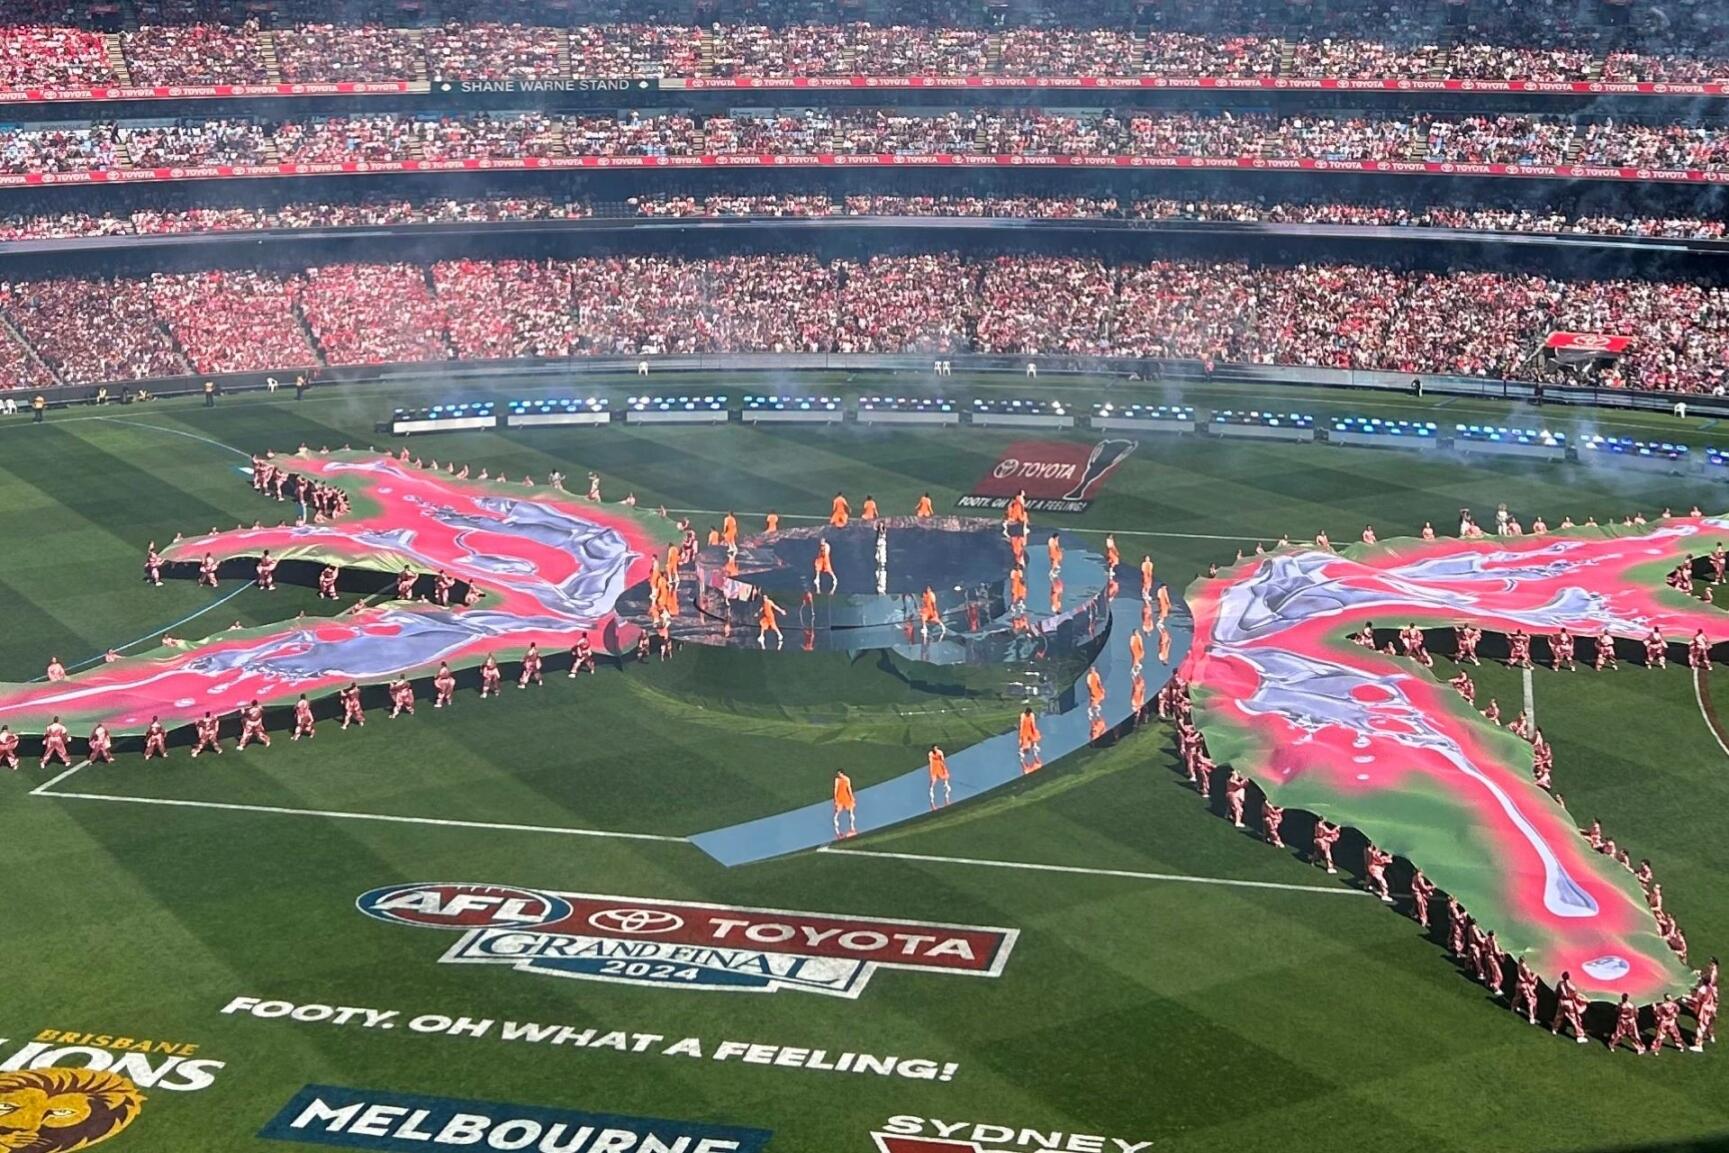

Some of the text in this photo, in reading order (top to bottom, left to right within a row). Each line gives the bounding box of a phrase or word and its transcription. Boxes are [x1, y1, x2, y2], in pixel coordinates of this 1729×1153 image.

[367, 83, 399, 91] TOYOTA
[461, 80, 629, 92] SHANE WARNE STAND
[60, 90, 92, 98] TOYOTA
[184, 87, 216, 95] TOYOTA
[0, 92, 27, 100] OYOTA
[551, 158, 583, 166] TOYOTA
[729, 156, 760, 164] TOYOTA
[1084, 157, 1116, 165] TOYOTA
[1268, 160, 1300, 168] TOYOTA
[308, 164, 342, 172] TOYOTA
[370, 162, 403, 170] TOYOTA
[431, 161, 464, 169] TOYOTA
[1329, 161, 1362, 169] TOYOTA
[1392, 163, 1426, 171] TOYOTA
[1455, 164, 1489, 172] TOYOTA
[185, 168, 219, 176] TOYOTA
[247, 166, 280, 174] TOYOTA
[1520, 166, 1555, 174] TOYOTA
[1586, 168, 1621, 177] TOYOTA
[56, 173, 90, 181] TOYOTA
[121, 170, 155, 179] TOYOTA
[1652, 171, 1688, 179] TOYOTA
[0, 176, 26, 184] OYOTA
[1017, 463, 1077, 479] TOYOTA
[993, 498, 1009, 508] OH
[1045, 501, 1087, 511] FEELING!
[369, 891, 545, 922] AFL
[708, 917, 976, 961] TOYOTA
[478, 933, 841, 984] GRAND FINAL
[599, 960, 700, 981] 2024
[33, 1029, 199, 1056] BRISBANE
[220, 996, 959, 1082] FOOTY. OH WHAT A FEELING!
[0, 1038, 226, 1091] IONS
[882, 1115, 1154, 1153] SYDNEY
